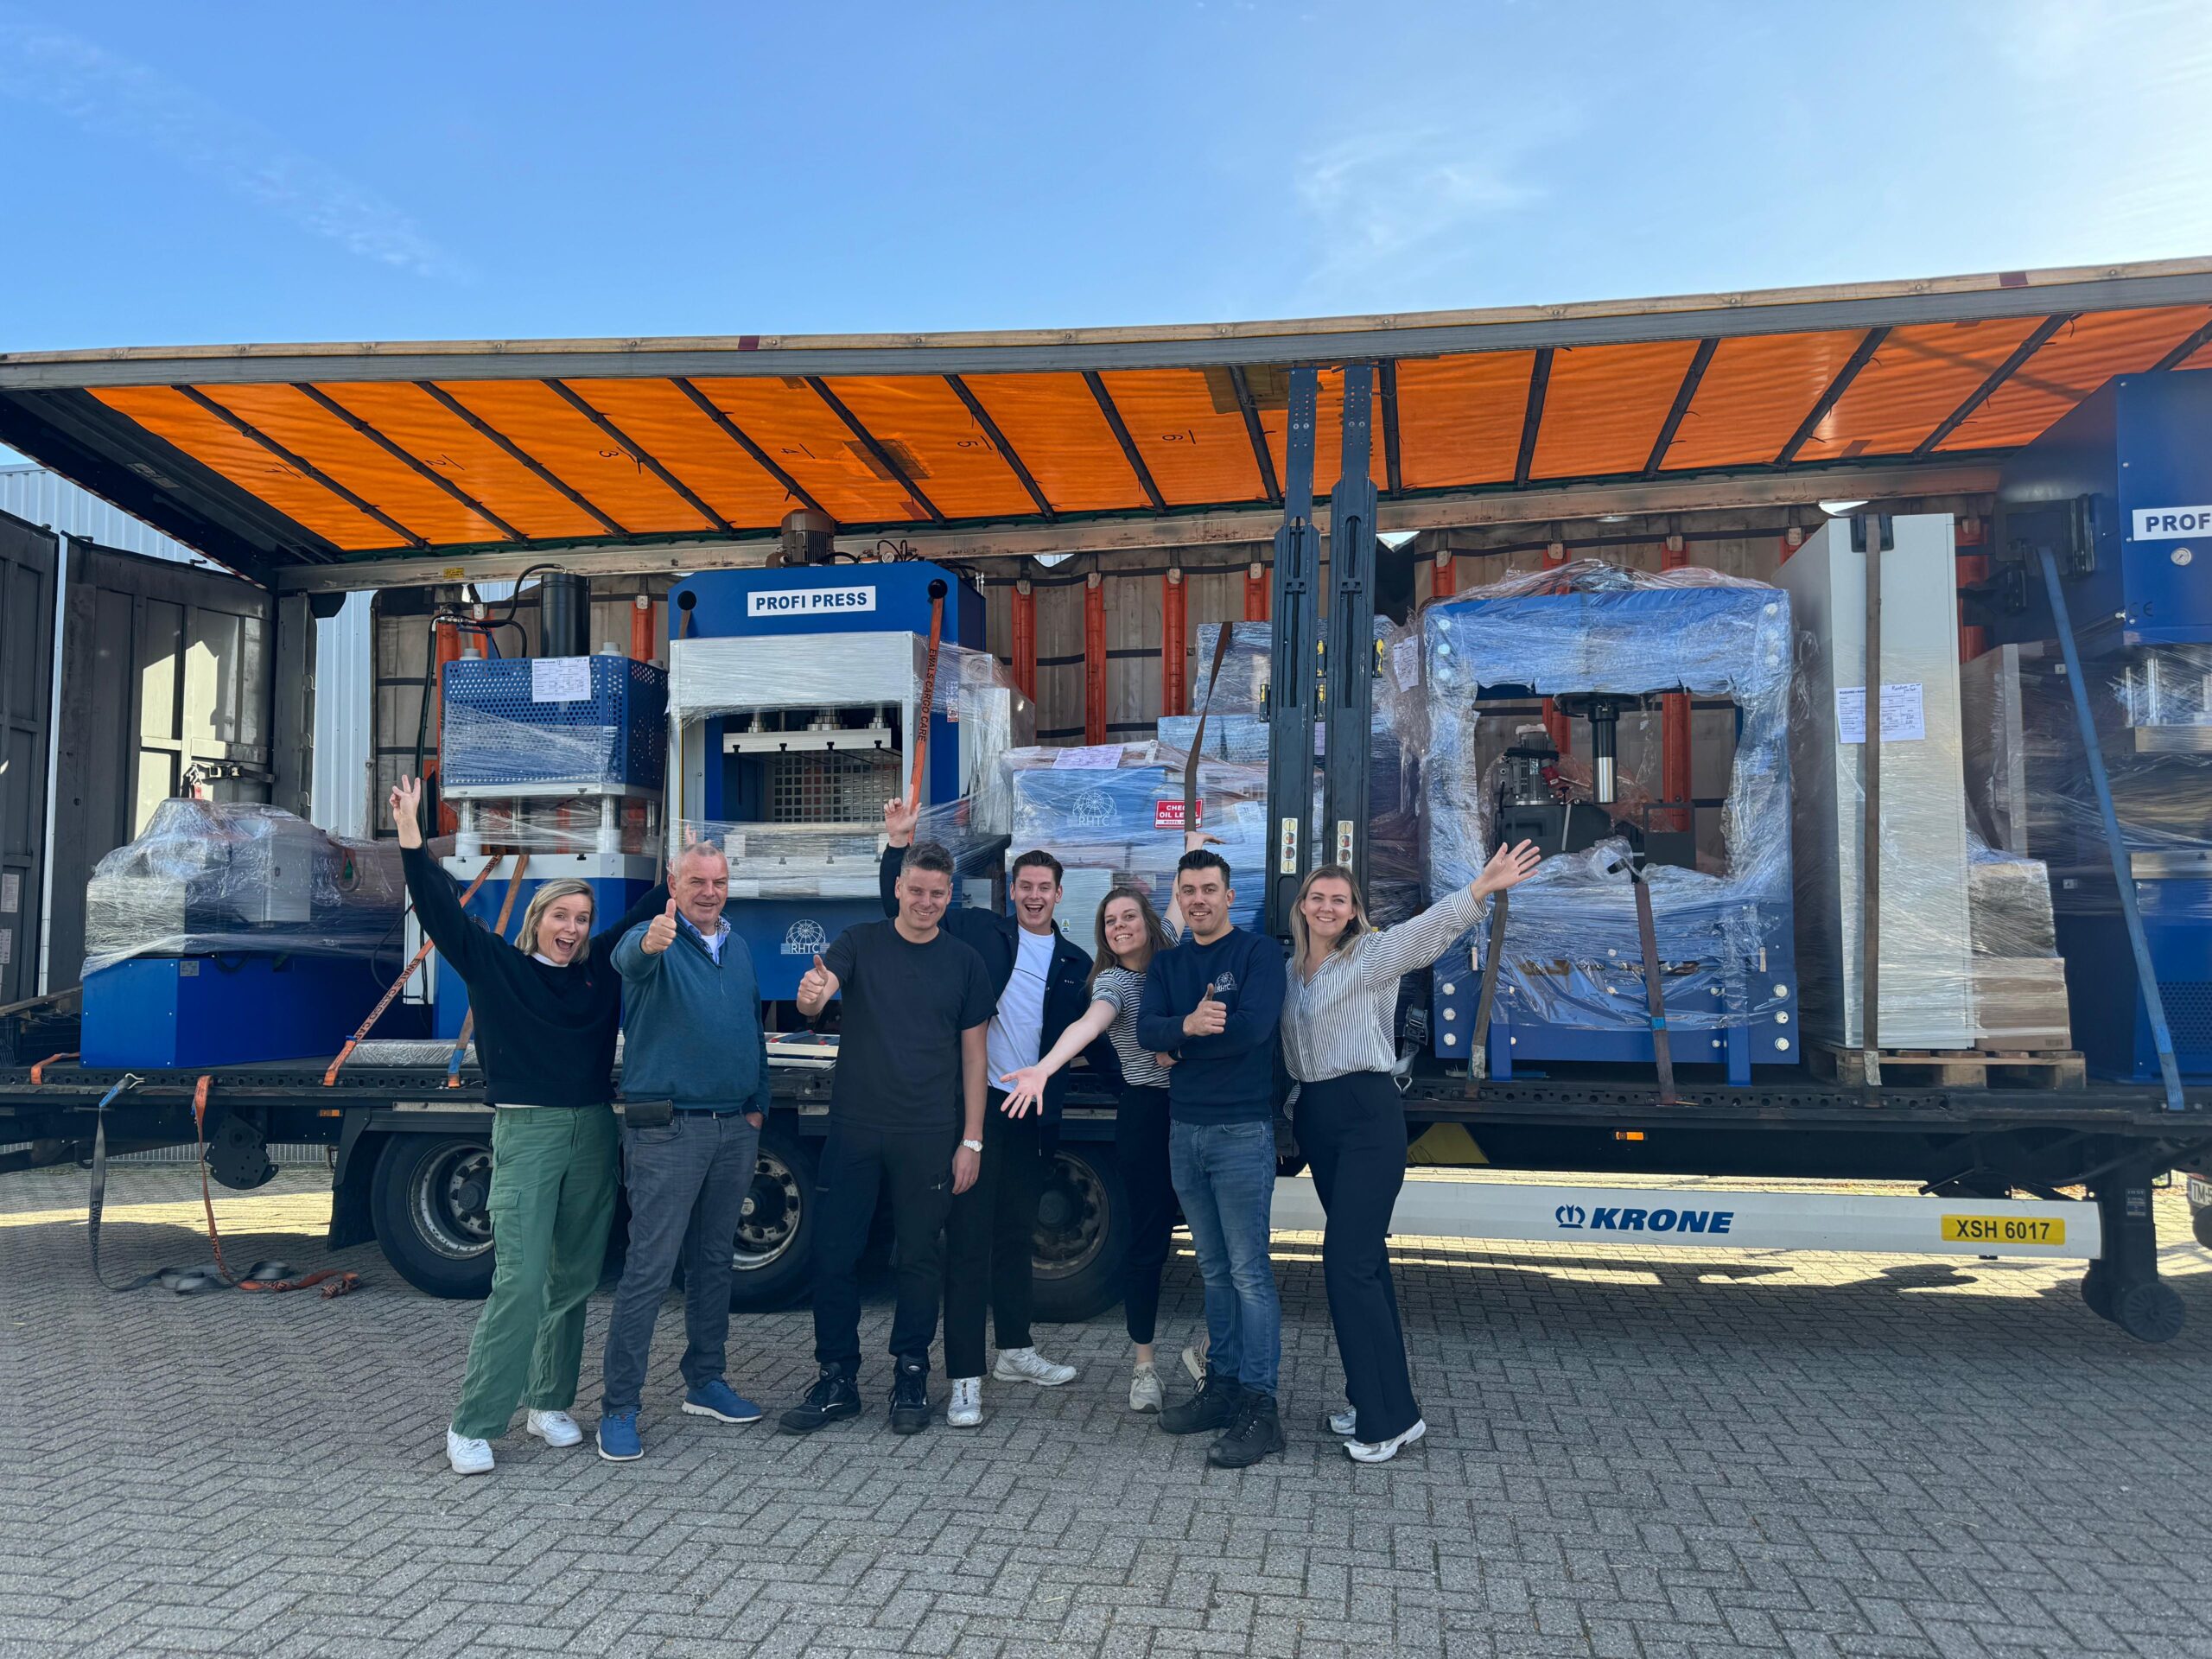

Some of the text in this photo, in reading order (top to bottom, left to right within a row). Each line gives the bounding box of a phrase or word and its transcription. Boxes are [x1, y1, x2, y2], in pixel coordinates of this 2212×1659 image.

[599, 449, 620, 459] 3
[2145, 512, 2212, 533] PROF
[756, 592, 868, 611] PROFI PRESS
[918, 648, 937, 742] EWALS CARGO CARE
[1078, 816, 1109, 827] RHTC
[791, 943, 819, 954] RHTC
[1217, 983, 1231, 993] RHTC
[354, 958, 421, 1039] EWALS CARGO CAR
[1590, 1208, 1735, 1234] KRONE
[1956, 1219, 2050, 1239] XSH 6017
